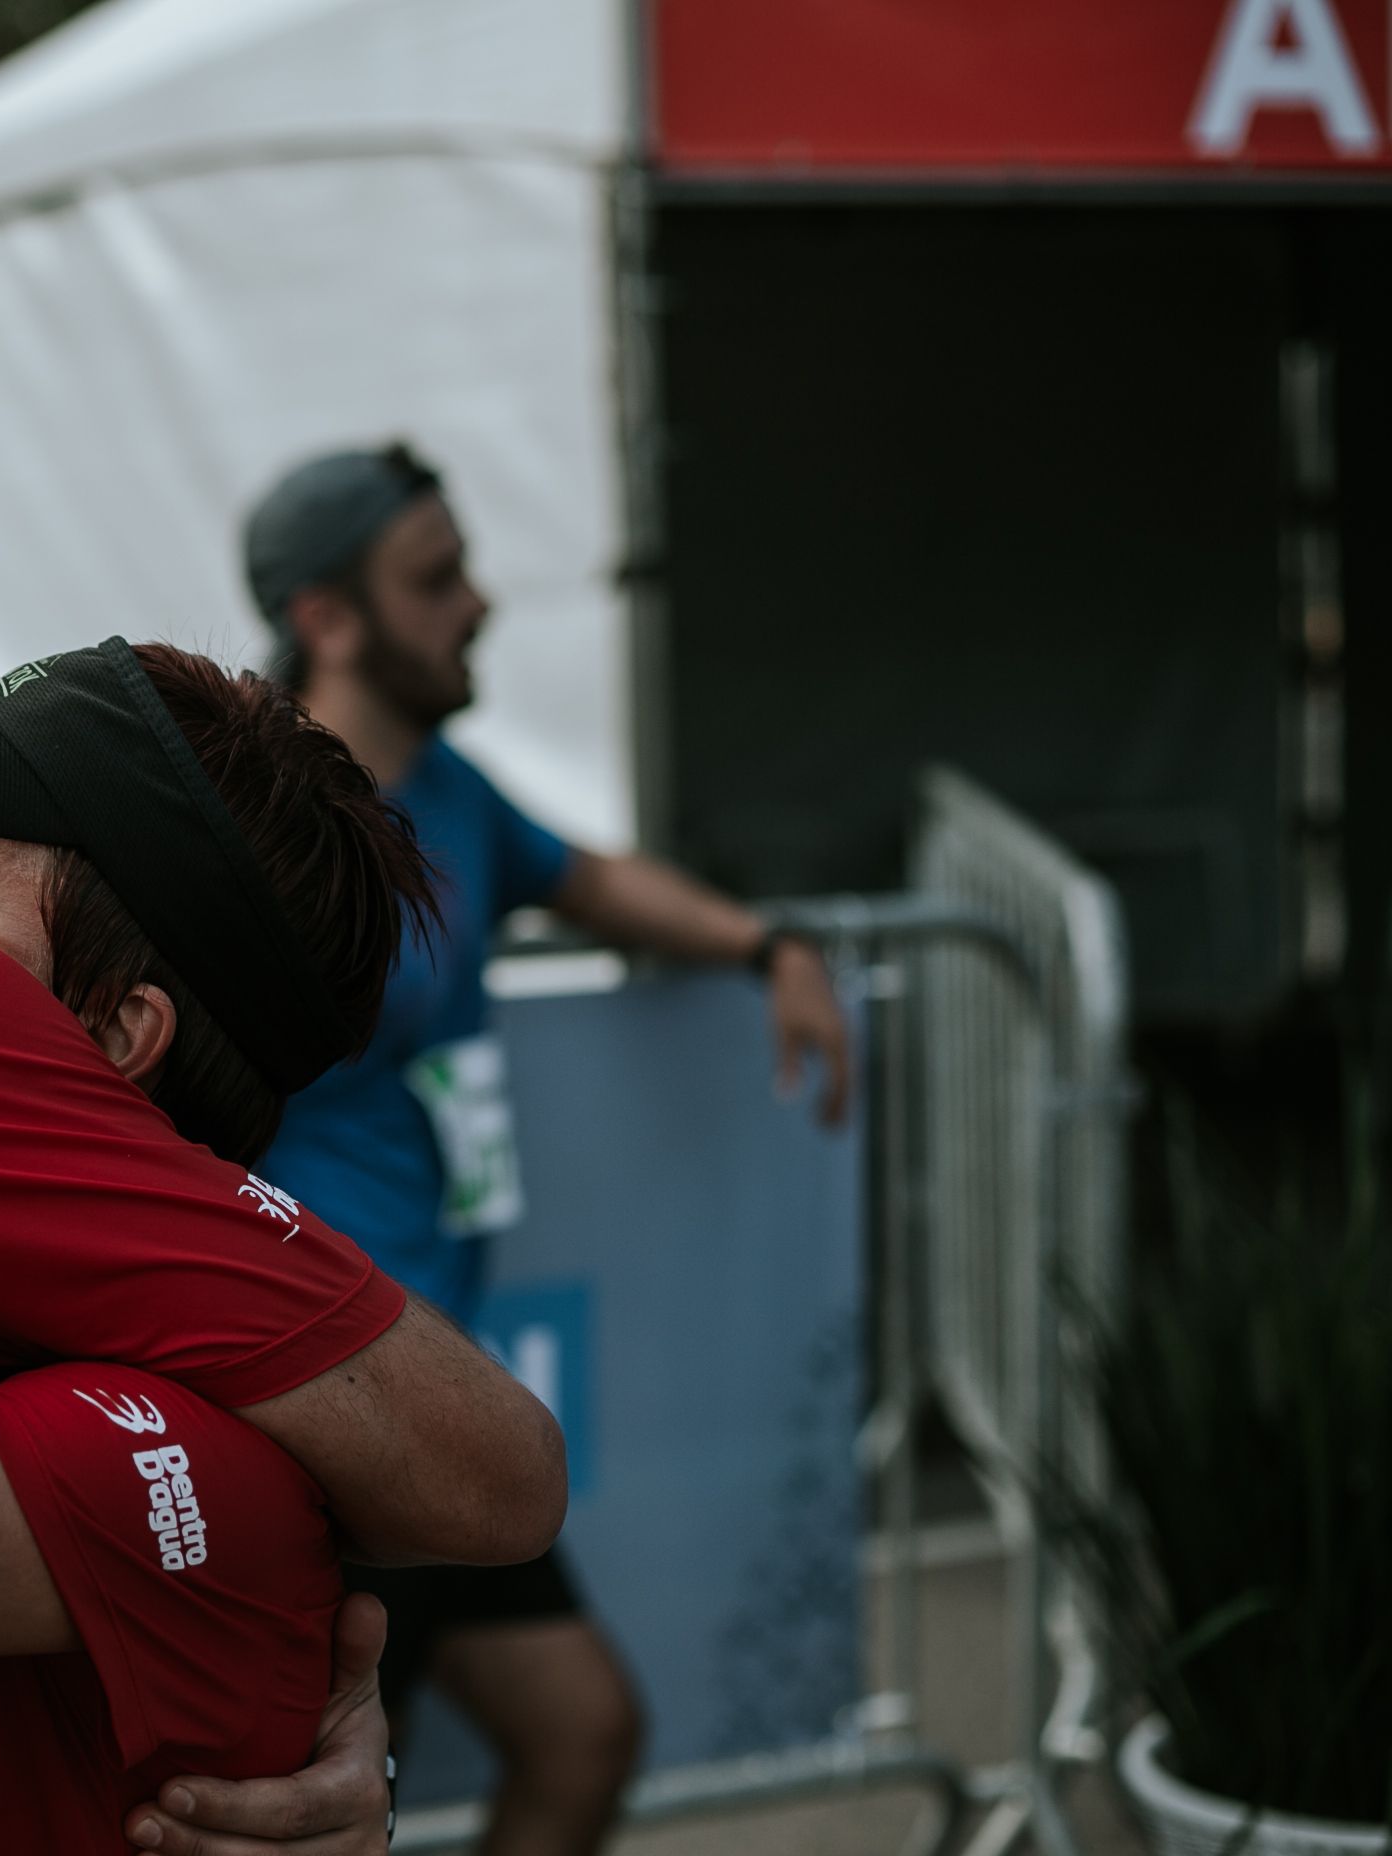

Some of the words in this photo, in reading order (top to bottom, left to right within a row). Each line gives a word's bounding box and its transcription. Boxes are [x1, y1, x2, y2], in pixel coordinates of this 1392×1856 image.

[1185, 0, 1392, 158] A
[132, 1449, 185, 1571] D'agua
[158, 1444, 208, 1566] Dentro
